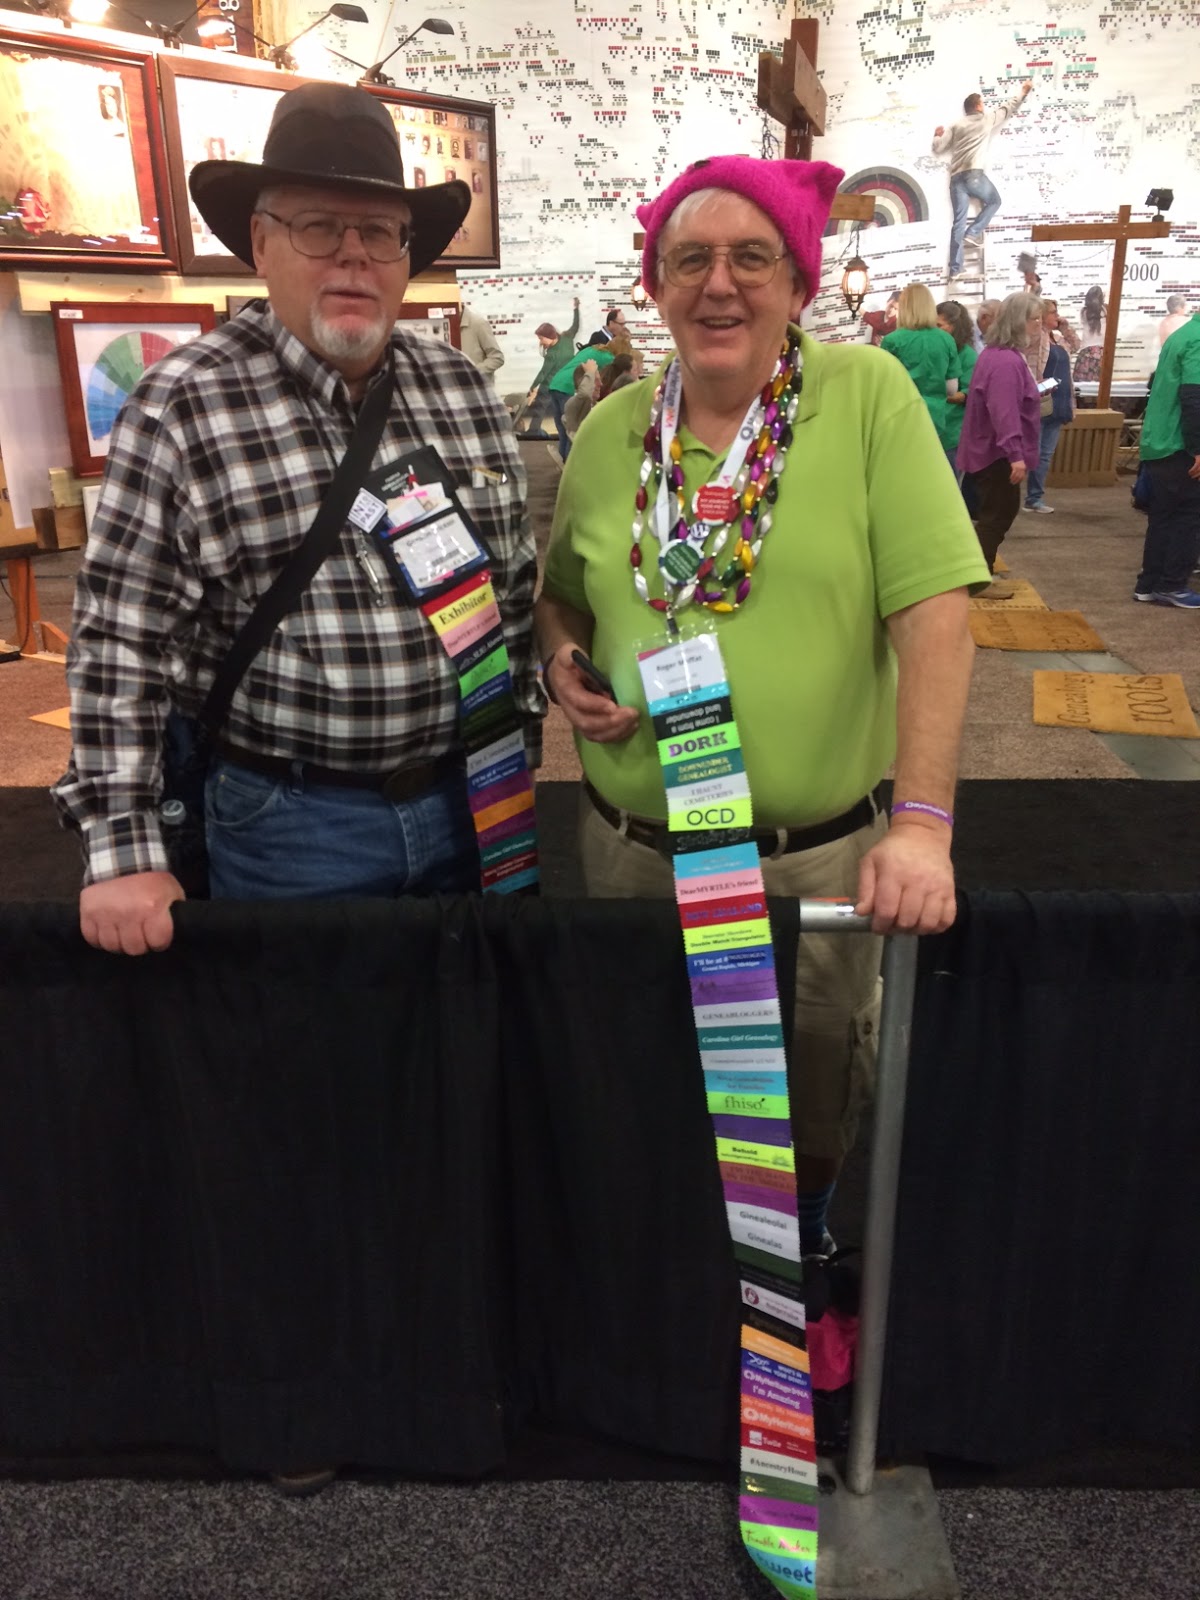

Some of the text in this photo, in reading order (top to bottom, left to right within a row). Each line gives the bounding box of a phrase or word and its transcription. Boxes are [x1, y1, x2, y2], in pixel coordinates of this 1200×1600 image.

[1123, 263, 1160, 282] 2000
[438, 592, 488, 625] Exhibitor
[656, 655, 703, 672] Roger Mffat
[1057, 673, 1096, 725] Genealogy
[1114, 675, 1176, 726] roots
[668, 731, 729, 758] DORK
[683, 789, 734, 806] CEMETERIES
[686, 808, 736, 826] OCD
[702, 1035, 730, 1044] Carolina
[744, 1033, 778, 1042] Genealogy
[767, 1390, 801, 1410] Amazing
[759, 1413, 811, 1437] MyHeritage
[750, 1457, 808, 1478] #AncestryHour
